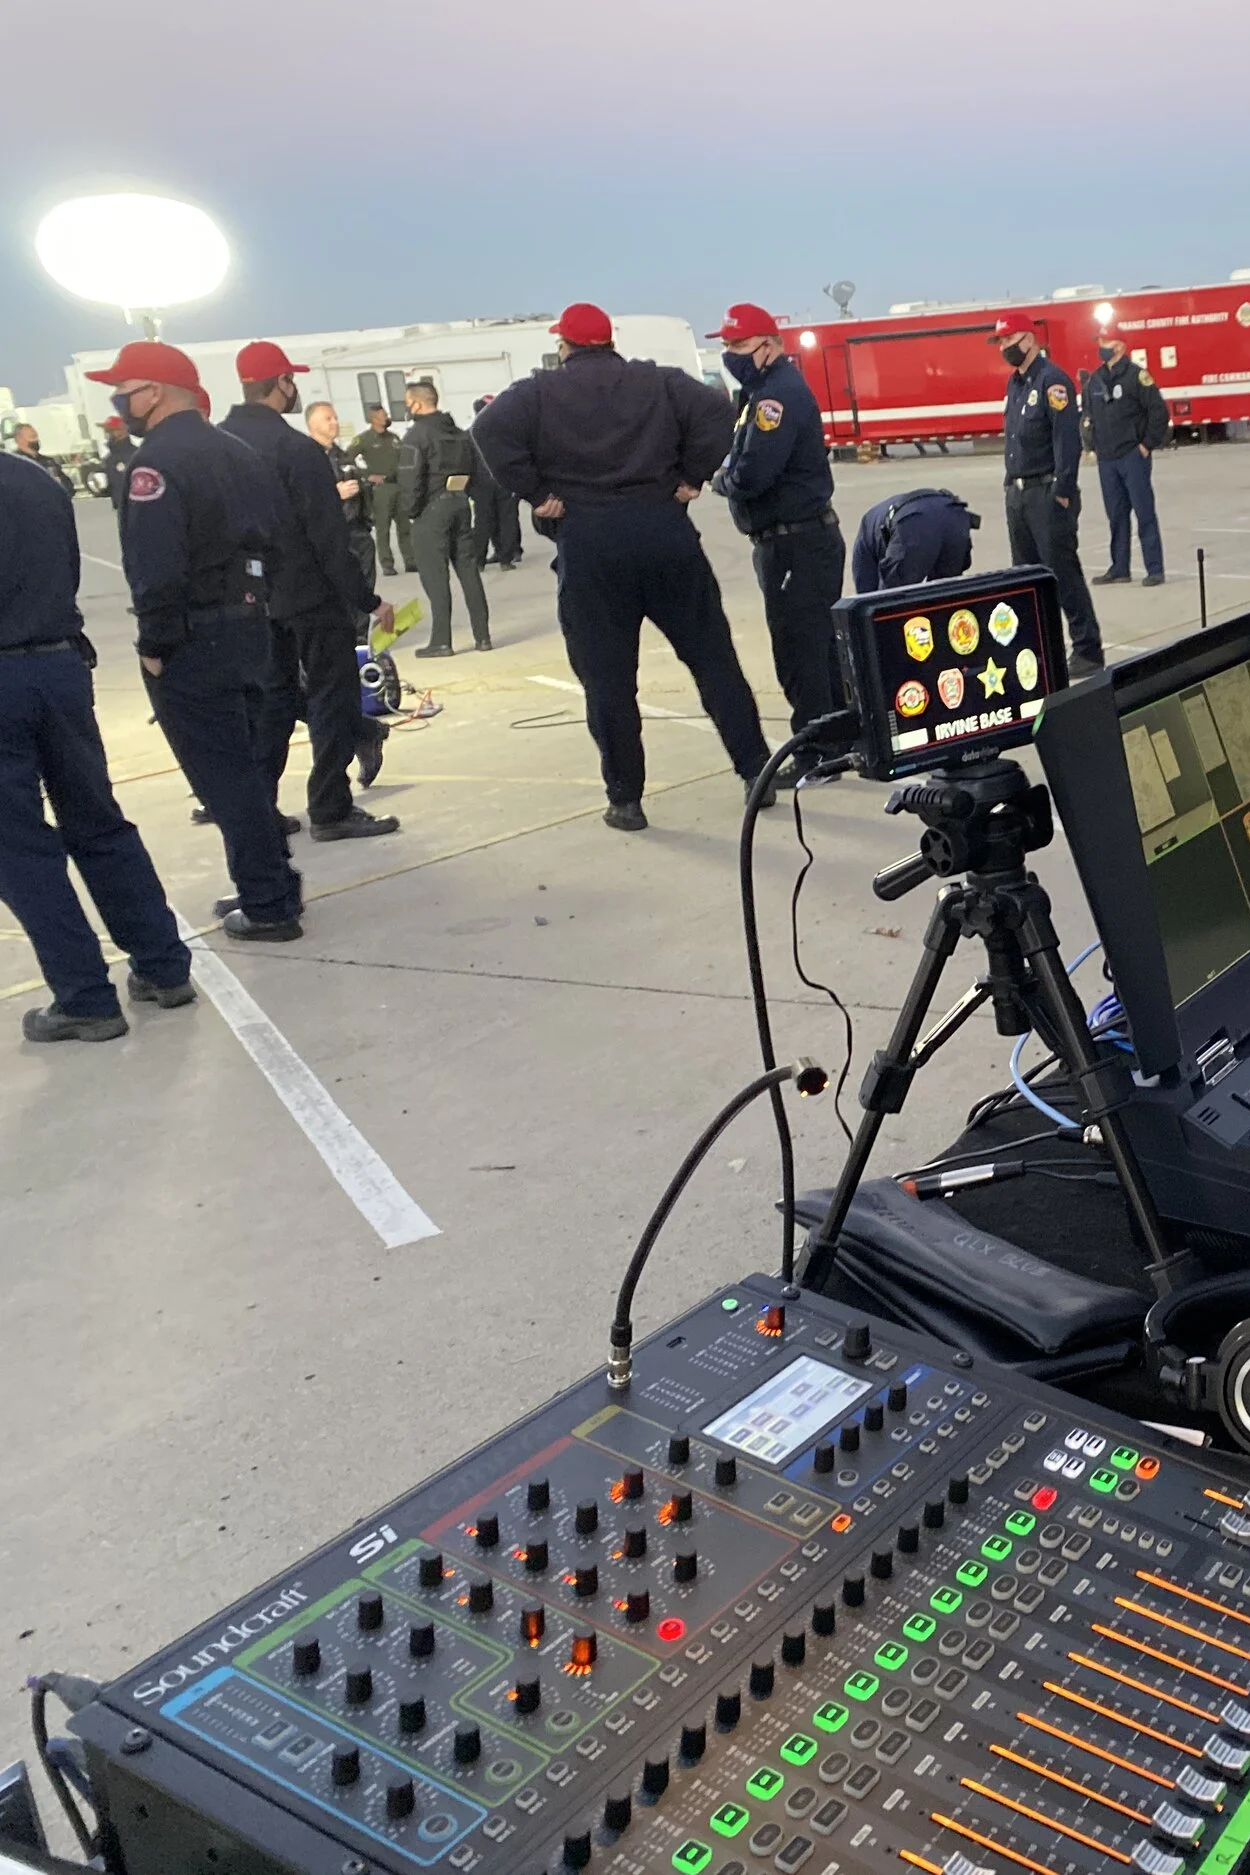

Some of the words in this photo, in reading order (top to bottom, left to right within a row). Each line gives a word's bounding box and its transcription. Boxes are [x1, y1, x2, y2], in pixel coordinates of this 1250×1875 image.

[935, 715, 980, 741] IRVINE
[980, 706, 1013, 729] BASE
[349, 1524, 398, 1564] Si
[133, 1587, 308, 1707] Soundcraft
